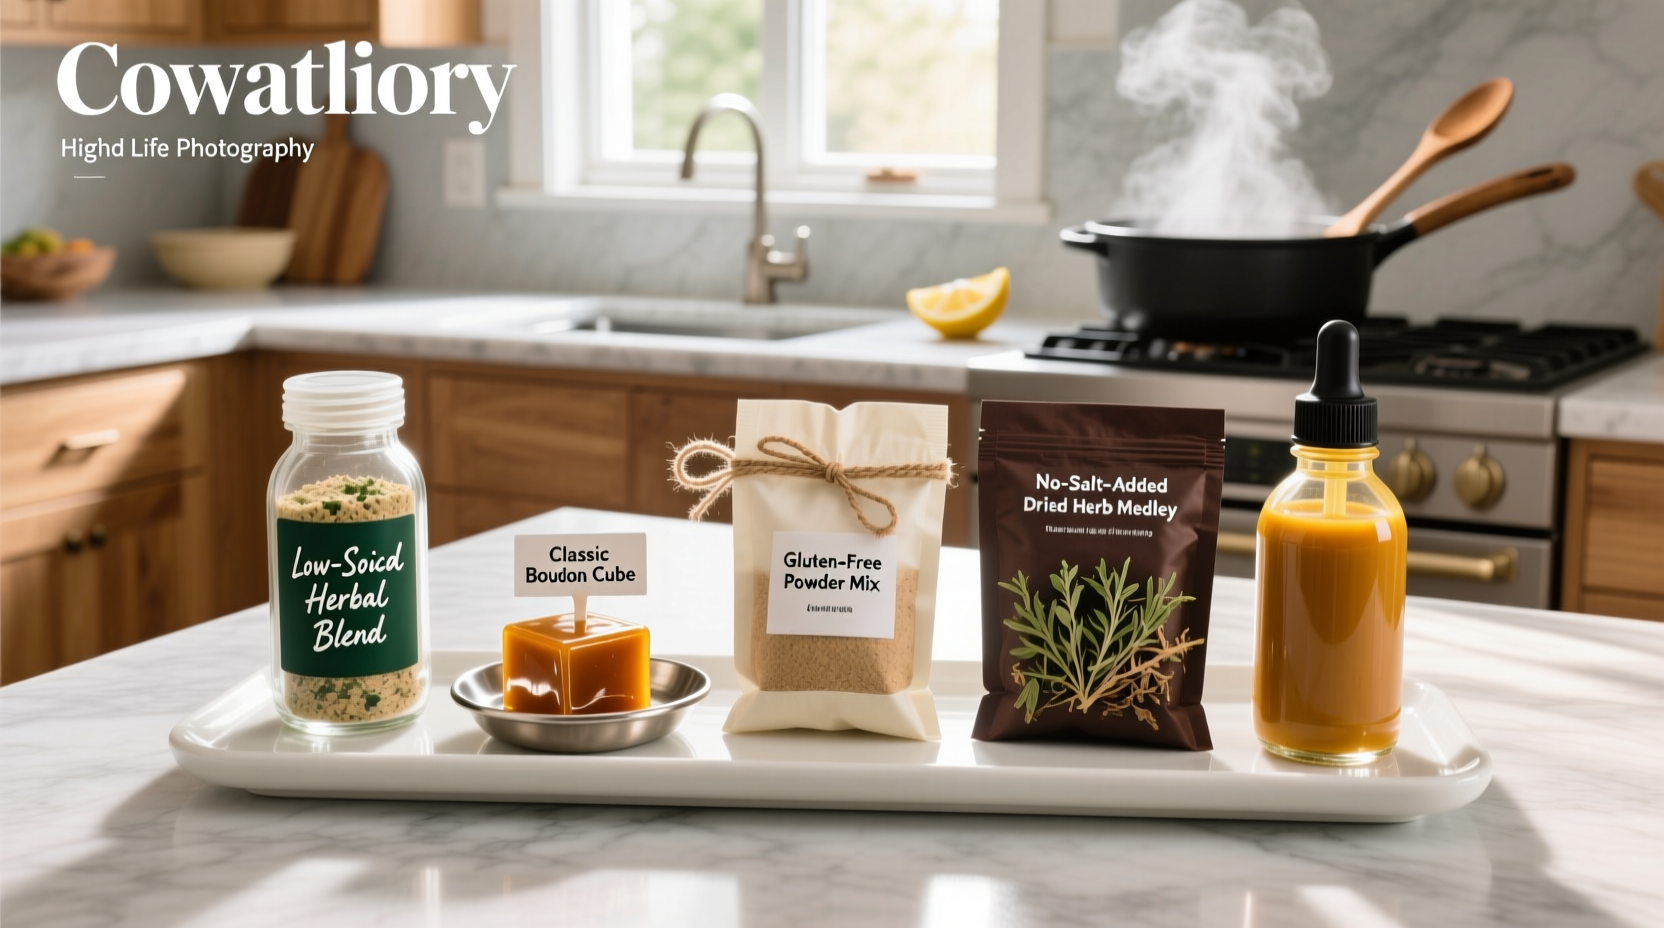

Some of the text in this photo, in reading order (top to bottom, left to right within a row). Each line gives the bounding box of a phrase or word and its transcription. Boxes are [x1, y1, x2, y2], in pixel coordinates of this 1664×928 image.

[1036, 473, 1168, 493] No-Salt-Added
[1023, 496, 1178, 522] Dried Herb Medley
[549, 545, 610, 562] Classic
[783, 551, 882, 570] Gluten-Free
[525, 565, 636, 583] Boudon Cube
[784, 573, 881, 592] Powder Mix
[304, 579, 389, 615] Herbal
[312, 614, 387, 652] Blend
